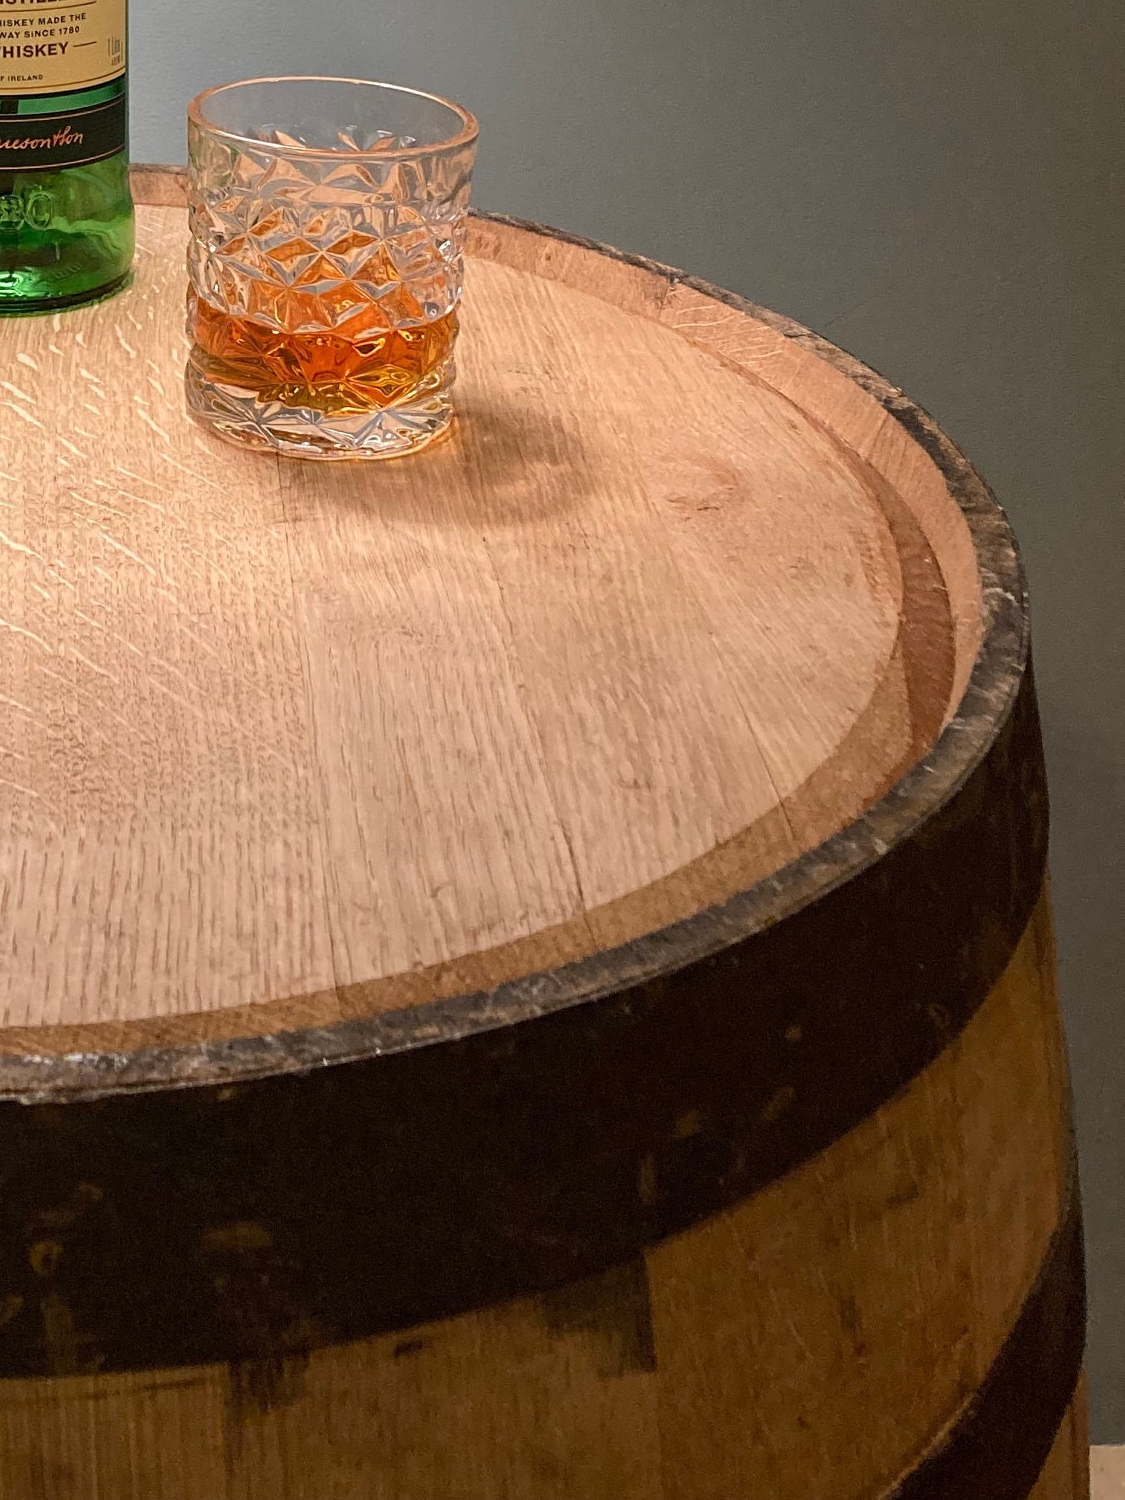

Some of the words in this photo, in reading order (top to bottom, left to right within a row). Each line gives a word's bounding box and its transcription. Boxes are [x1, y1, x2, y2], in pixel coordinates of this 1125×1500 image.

[38, 15, 66, 25] MADE
[69, 12, 86, 22] THE
[24, 28, 55, 38] SINCE
[58, 25, 80, 35] 1780
[7, 74, 43, 82] IRELAND
